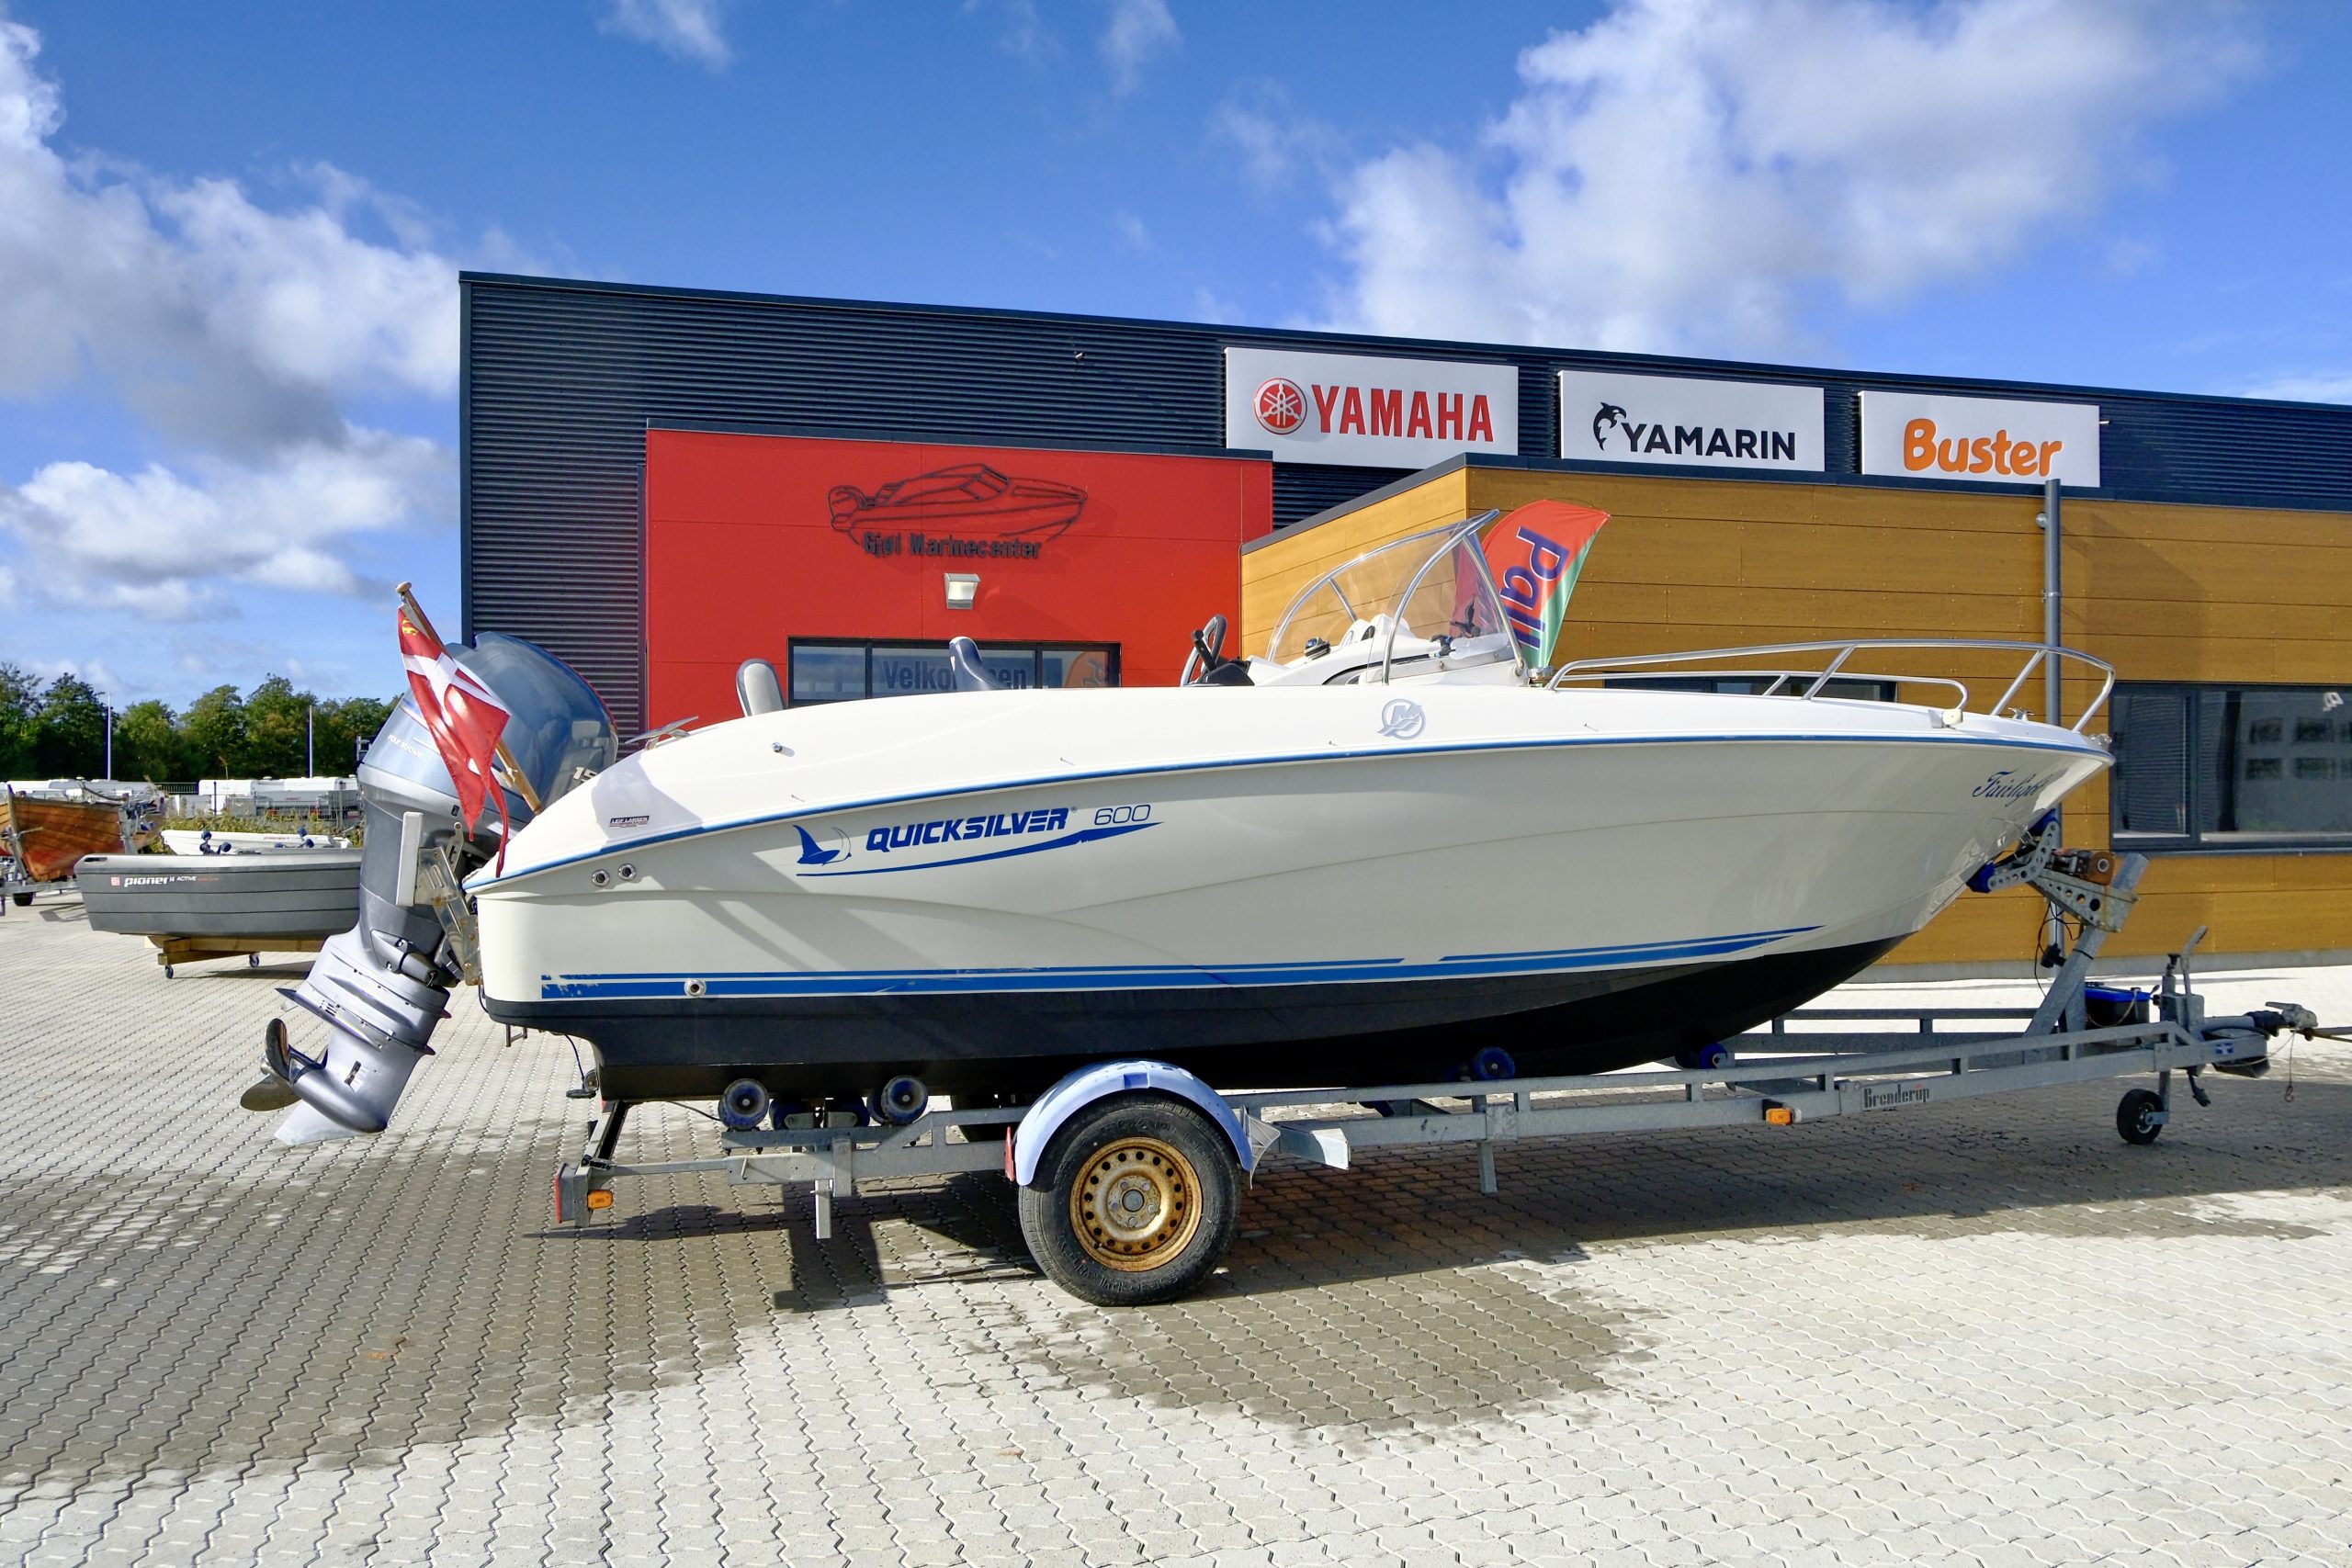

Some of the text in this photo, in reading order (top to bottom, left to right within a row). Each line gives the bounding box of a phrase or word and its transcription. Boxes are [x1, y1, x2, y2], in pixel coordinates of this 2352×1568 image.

[1312, 384, 1494, 442] YAMAHA
[1622, 423, 1795, 461] YAMARIN
[1904, 418, 2064, 477] Buster
[910, 533, 1042, 558] Marinecenter
[883, 660, 1026, 689] Velkoen
[865, 804, 1151, 852] QUICKSILVER 600
[123, 876, 169, 888] pioner
[1863, 1084, 1930, 1108] Brenderup
